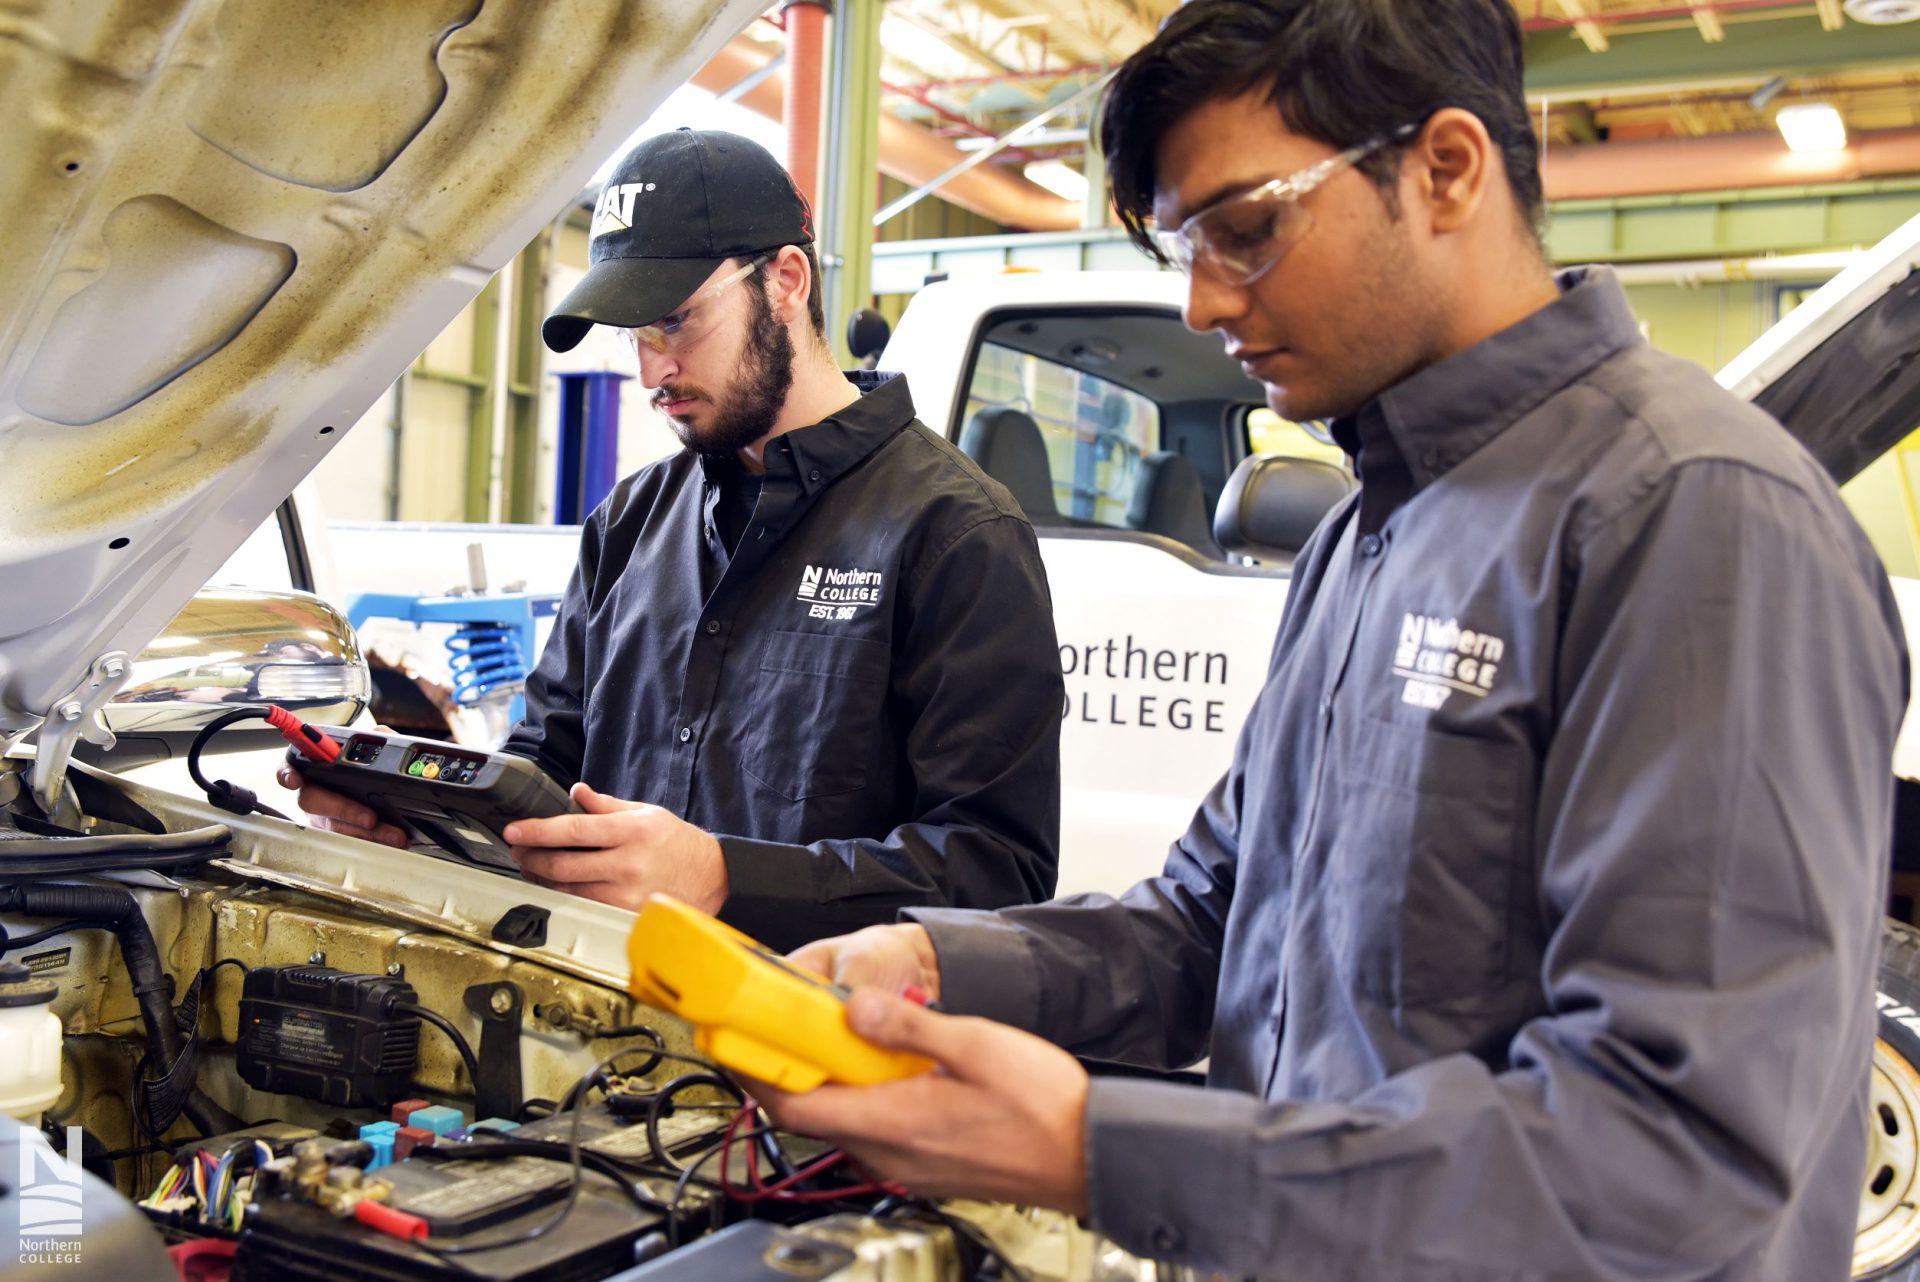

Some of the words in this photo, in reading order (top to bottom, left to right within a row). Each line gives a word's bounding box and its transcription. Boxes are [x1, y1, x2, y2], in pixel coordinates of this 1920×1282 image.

[825, 567, 882, 585] Northern
[820, 587, 879, 601] COLLEGE
[808, 604, 834, 620] EST.
[1059, 635, 1228, 685] orthern
[1062, 692, 1225, 733] LLEGE
